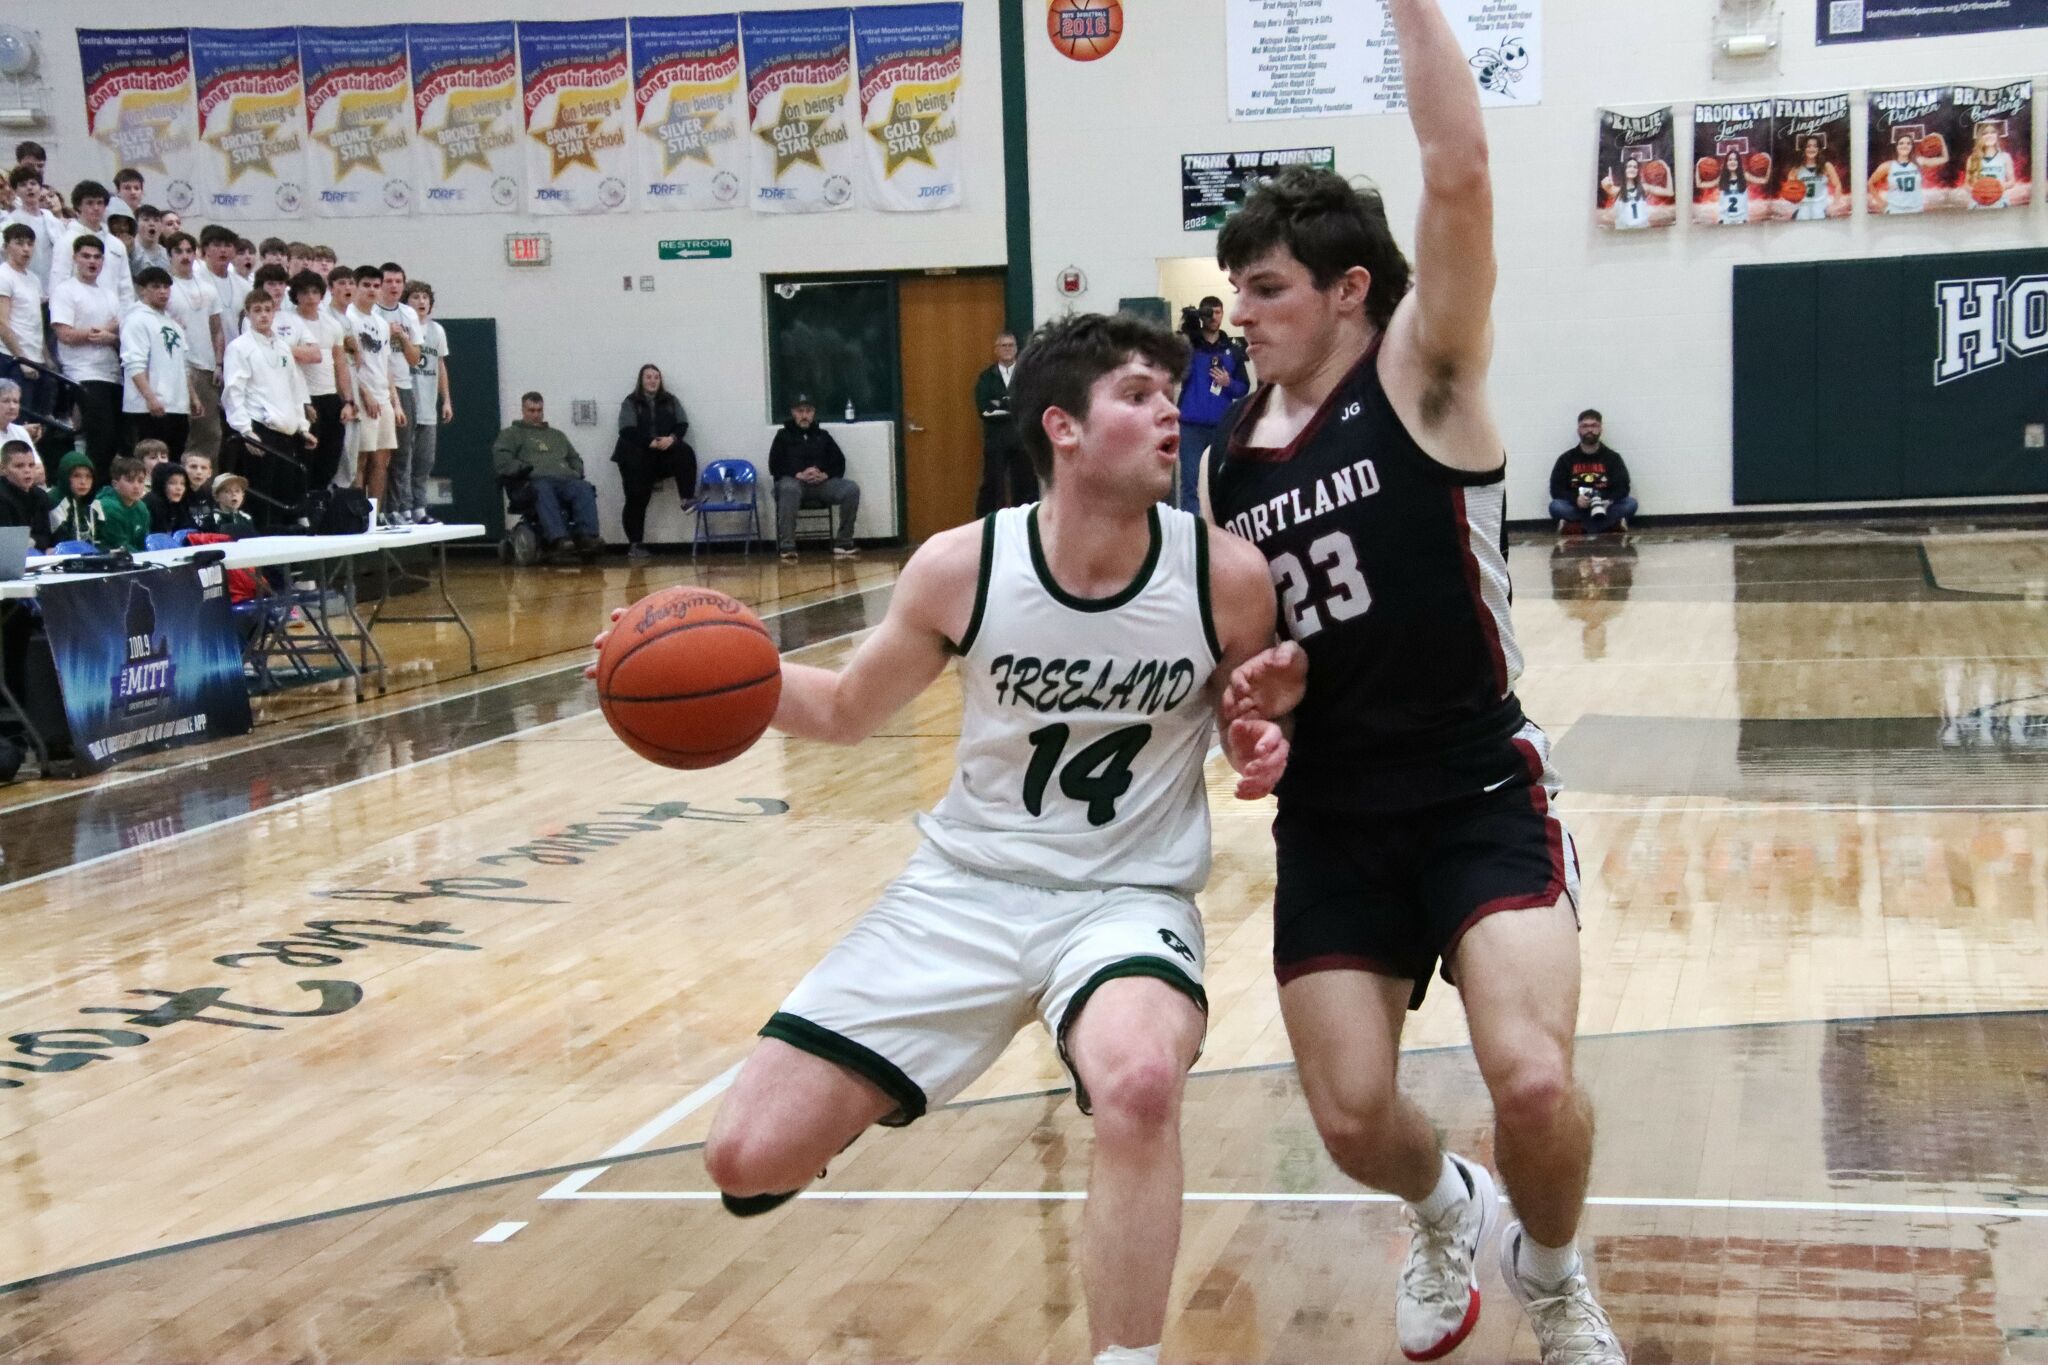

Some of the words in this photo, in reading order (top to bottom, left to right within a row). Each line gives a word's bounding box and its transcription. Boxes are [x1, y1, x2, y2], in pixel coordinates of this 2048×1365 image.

[905, 48, 930, 58] raised
[88, 66, 189, 112] Congratulations
[307, 66, 407, 111] Congratulations
[415, 63, 515, 111] Congratulations
[525, 62, 627, 110] Congratulations
[636, 56, 738, 105] Congratulations
[749, 57, 849, 106] Congratulations
[861, 54, 961, 105] Congratulations
[200, 70, 299, 114] Congratulations
[1877, 90, 1938, 110] JORDAN
[1953, 82, 2032, 106] BRAELYN
[580, 100, 611, 117] being
[693, 95, 725, 112] being
[804, 95, 835, 114] being
[916, 94, 949, 112] being
[1695, 102, 1771, 123] BROOKLYN
[1775, 96, 1848, 118] FRANCINE
[437, 122, 480, 145] BRONZE
[658, 118, 703, 140] SILVER
[772, 121, 809, 142] GOLD
[883, 120, 920, 140] GOLD
[925, 121, 956, 146] school
[1612, 113, 1662, 133] KARLIE
[1714, 119, 1754, 141] James
[220, 129, 265, 149] BRONZE
[329, 125, 373, 147] BRONZE
[545, 124, 590, 145] BRONZE
[588, 128, 625, 149] school
[667, 135, 701, 154] STAR
[702, 126, 736, 144] school
[813, 122, 849, 147] school
[887, 135, 922, 155] STAR
[123, 142, 153, 162] STAR
[233, 145, 261, 164] STAR
[340, 142, 369, 161] STAR
[449, 139, 476, 158] STAR
[556, 141, 585, 159] STAR
[777, 138, 811, 157] STAR
[1184, 154, 1230, 170] THANK
[1233, 152, 1260, 168] YOU
[1261, 148, 1332, 167] SPONSORS
[535, 188, 564, 201] JDRF
[647, 183, 676, 195] JDRF
[758, 187, 786, 199] JDRF
[917, 184, 948, 198] JDRF
[1895, 176, 1916, 192] 10
[1631, 202, 1638, 220] 1
[1727, 197, 1738, 213] 2
[1184, 215, 1207, 230] 2022
[514, 238, 540, 259] EXIT
[659, 239, 730, 250] RESTROOM
[1341, 401, 1361, 421] JG
[1269, 530, 1373, 640] 23
[128, 633, 151, 659] 100.9
[126, 659, 169, 696] MITT
[990, 654, 1195, 715] FREELAND
[1022, 722, 1153, 827] 14
[476, 797, 790, 869] Home
[311, 876, 571, 907] of
[213, 918, 483, 970] the
[0, 979, 364, 1089] Hor
